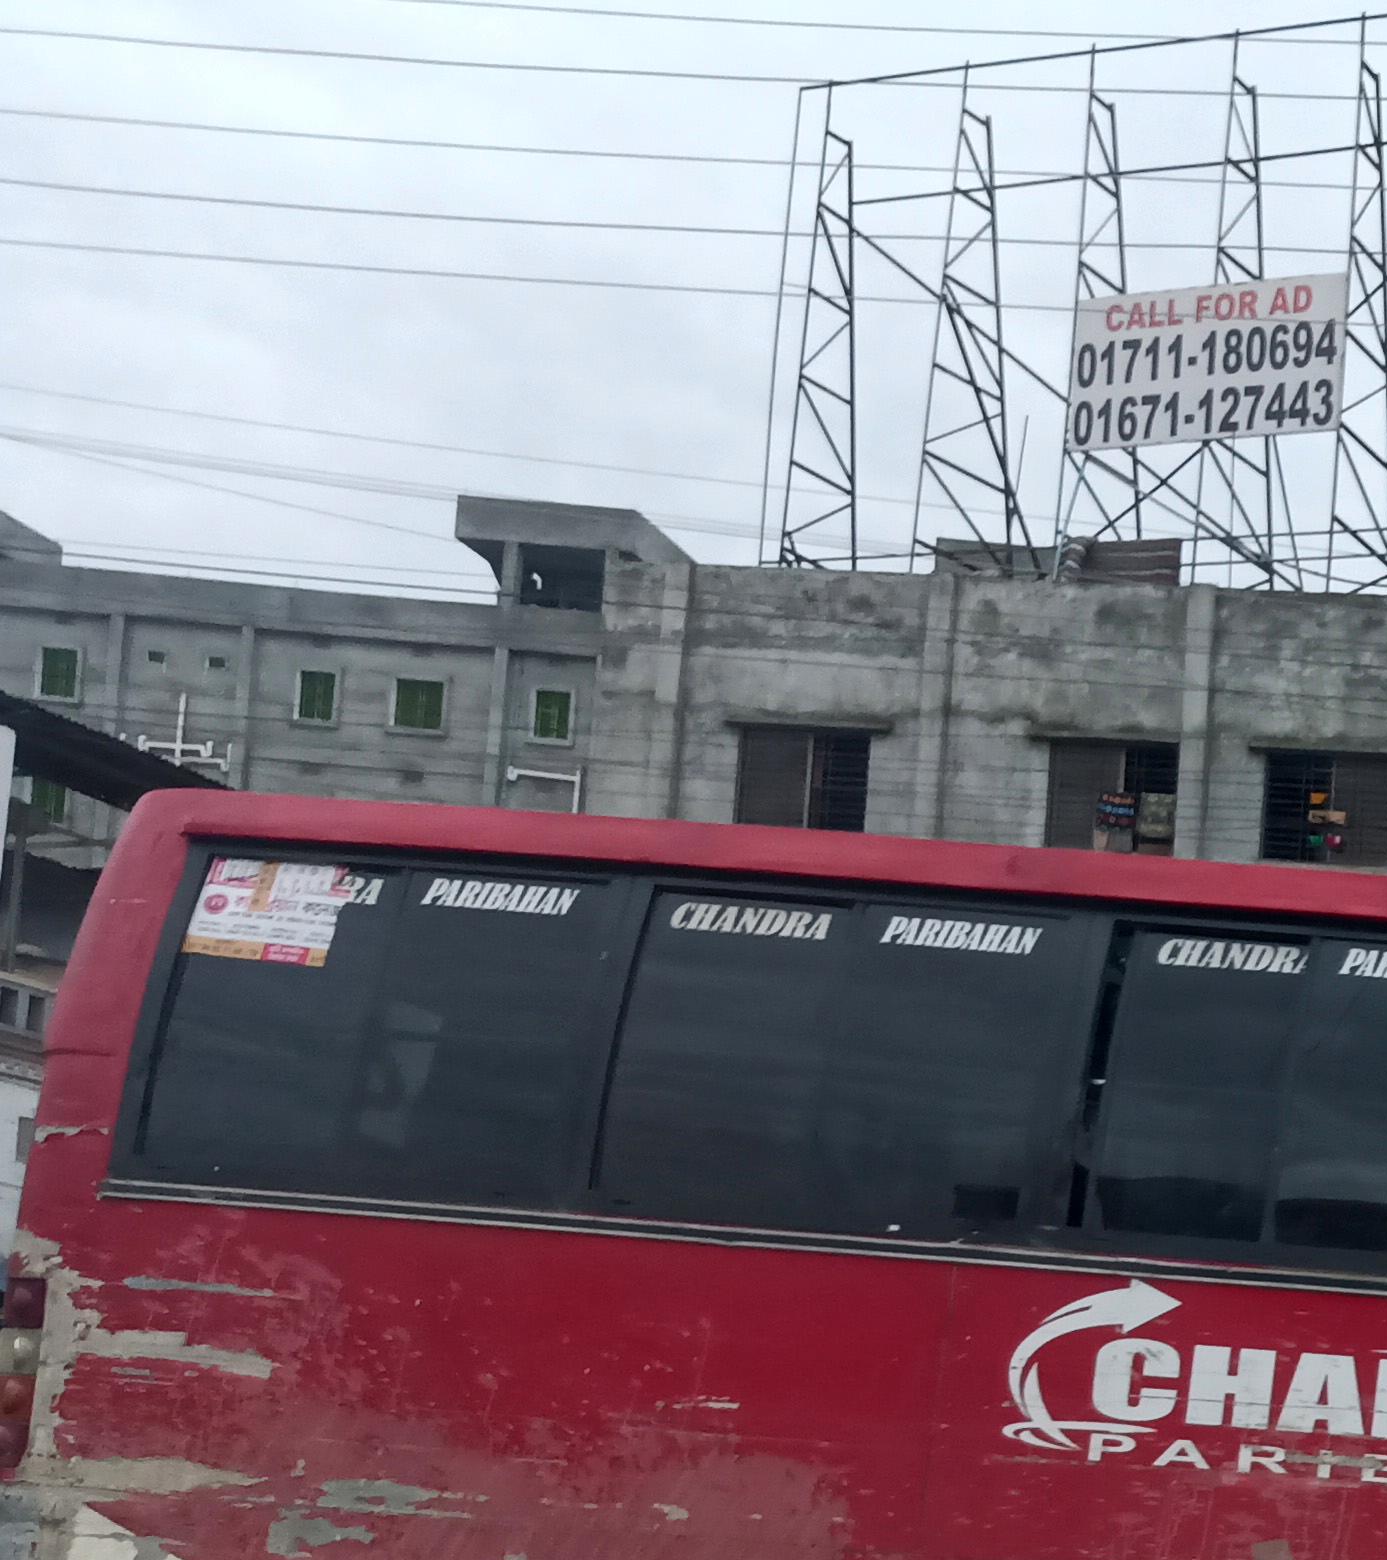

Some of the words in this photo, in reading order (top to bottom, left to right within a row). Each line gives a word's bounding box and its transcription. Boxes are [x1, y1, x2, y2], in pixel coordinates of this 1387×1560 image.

[1105, 299, 1183, 332] CALL
[1195, 290, 1259, 323] FOR
[1268, 284, 1314, 315] AD
[1077, 318, 1338, 389] 01711-180694
[1073, 378, 1334, 447] 01671-127443
[420, 877, 580, 917] PARIBAHAN
[668, 901, 834, 941] CHANDRA
[879, 915, 1044, 956] PARIBAHAN
